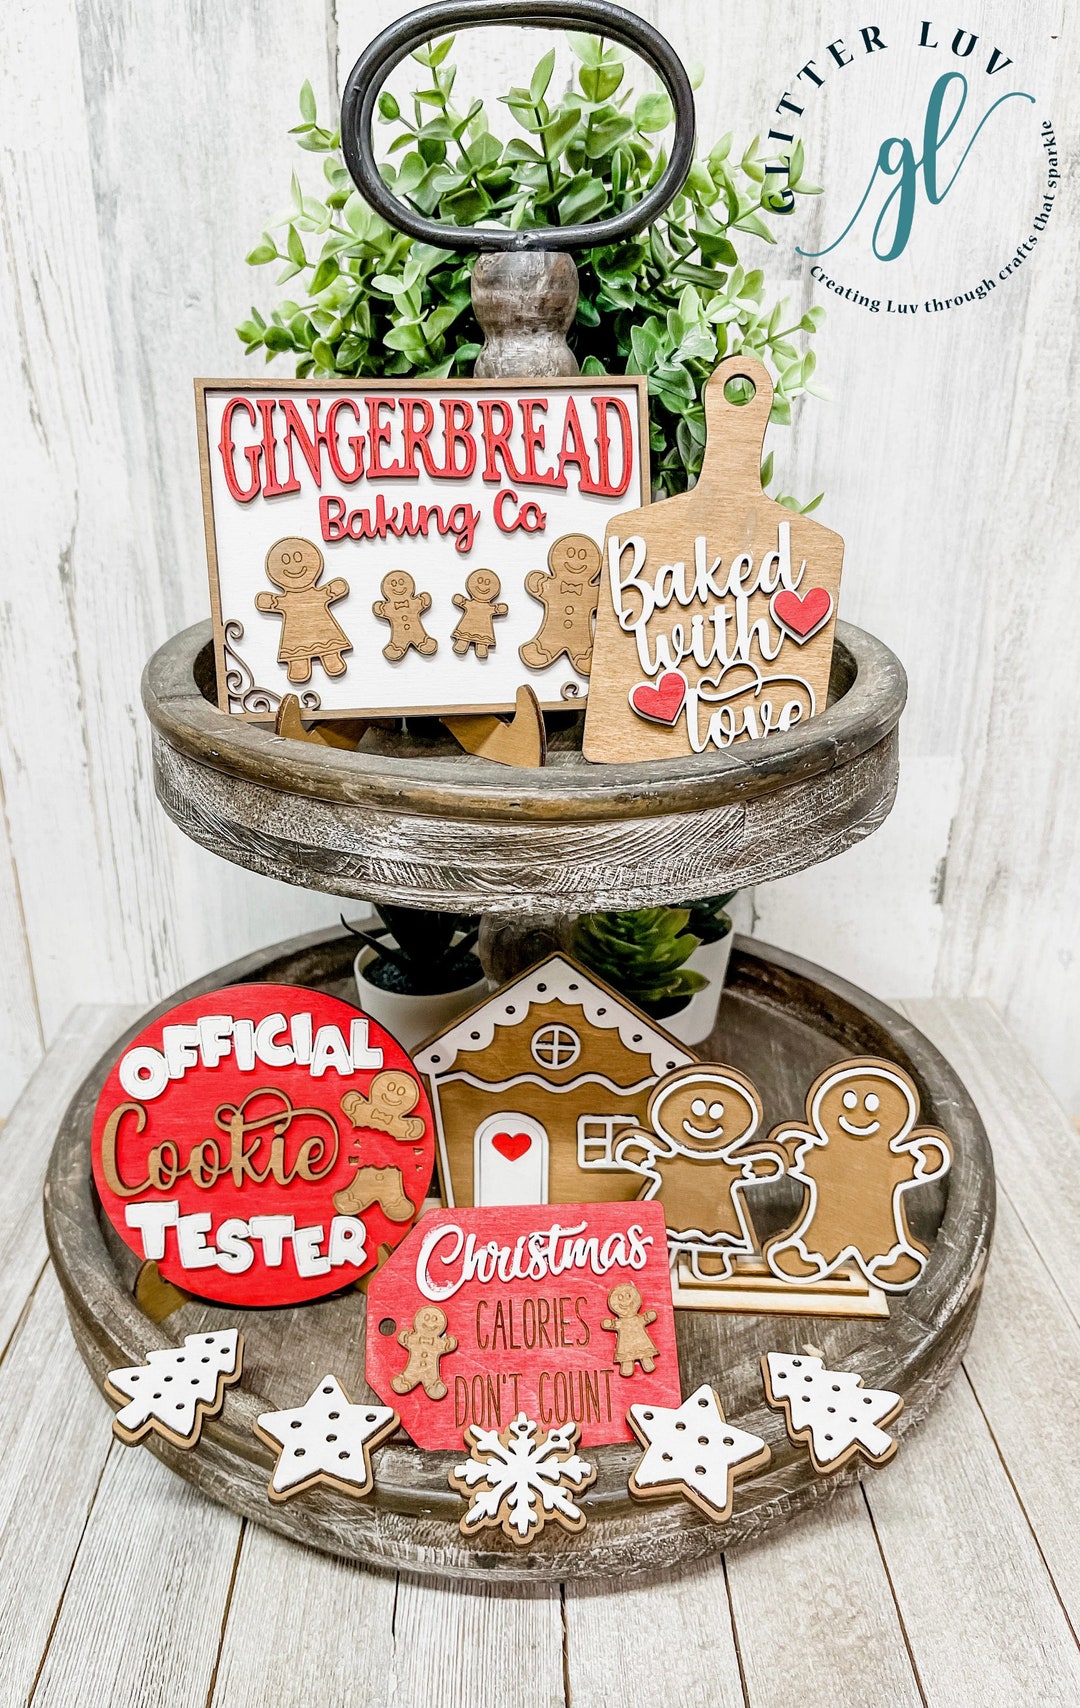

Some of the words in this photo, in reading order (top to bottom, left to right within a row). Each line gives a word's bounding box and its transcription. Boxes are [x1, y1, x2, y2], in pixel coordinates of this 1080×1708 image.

[218, 395, 635, 503] GINGERBREAD
[318, 494, 481, 553] Baking
[493, 488, 547, 534] Co
[608, 521, 807, 632] Baked
[635, 596, 786, 676] with
[684, 661, 816, 753] love
[119, 1012, 384, 1100] OFFICIAL
[101, 1086, 340, 1197] Cookie
[125, 1200, 369, 1278] TESTER
[415, 1220, 654, 1301] Christmas
[476, 1296, 591, 1351] CALORIES
[454, 1372, 523, 1428] DON'T
[538, 1369, 615, 1426] COUNT
